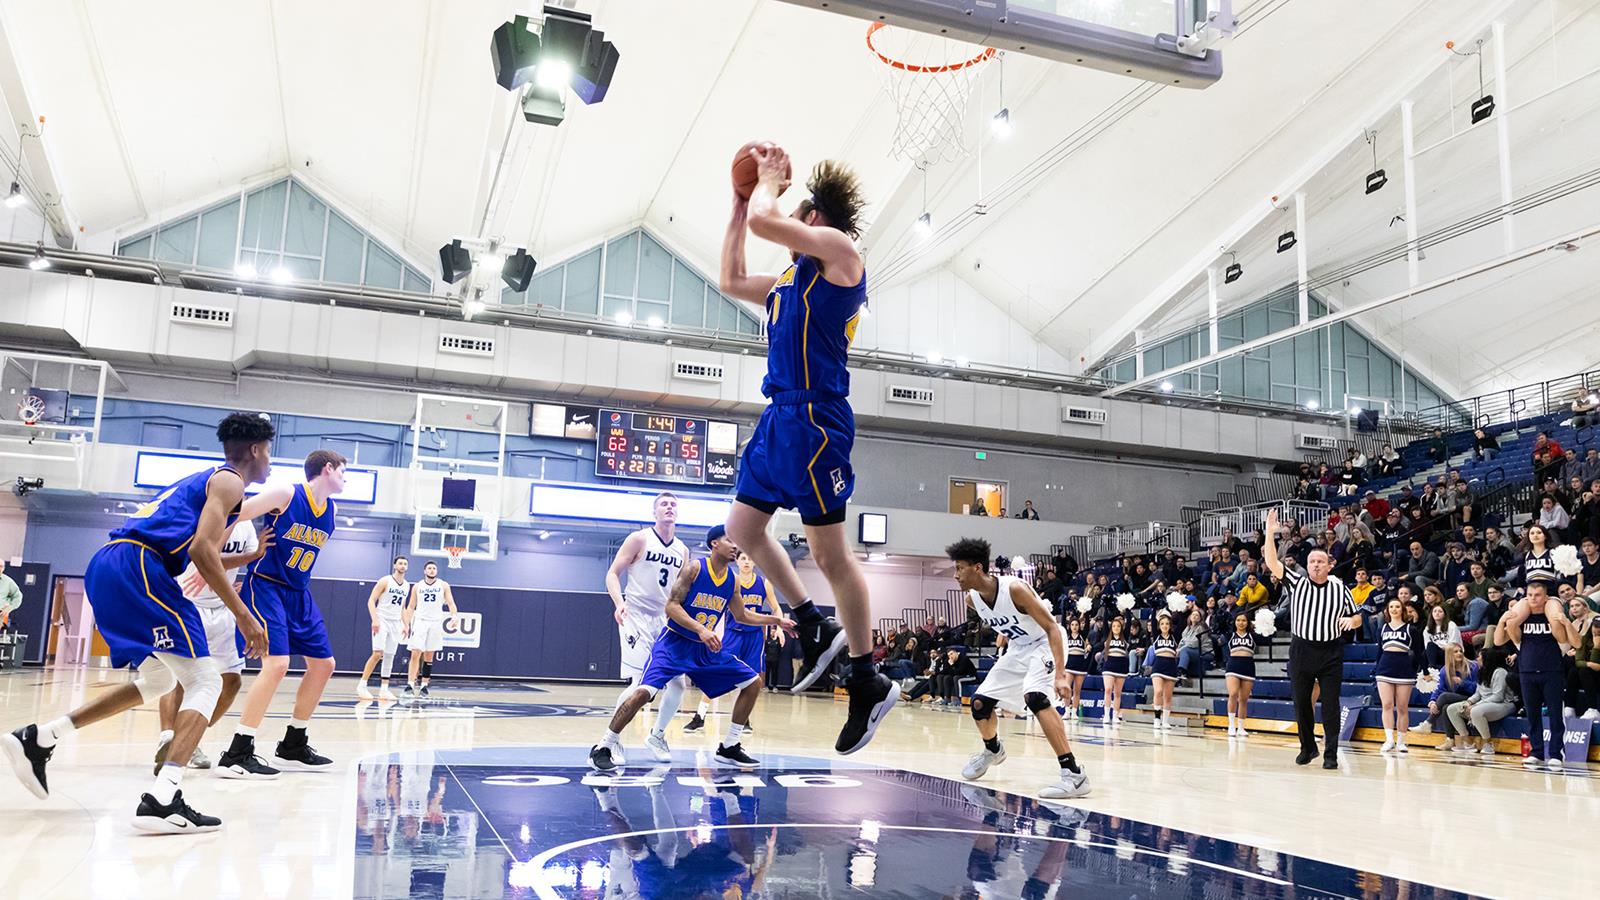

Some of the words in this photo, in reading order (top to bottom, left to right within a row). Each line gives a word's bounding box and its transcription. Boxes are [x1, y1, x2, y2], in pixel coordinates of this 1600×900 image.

[648, 416, 674, 431] 1:44
[608, 436, 627, 452] 62
[648, 441, 656, 453] 2
[681, 443, 699, 459] 55
[607, 458, 615, 470] 9
[619, 460, 626, 470] 2
[629, 460, 645, 473] 22
[647, 462, 655, 474] 3
[665, 463, 673, 476] 6
[707, 462, 735, 476] Woods
[694, 466, 701, 477] 7
[221, 540, 248, 553] WU
[286, 547, 316, 573] 10
[645, 550, 682, 569] WWU
[1526, 558, 1552, 570] WWU
[658, 567, 669, 588] 3
[391, 595, 403, 606] 24
[424, 593, 436, 602] 23
[442, 617, 477, 635] CU
[1523, 623, 1552, 635] WWU
[1382, 630, 1406, 640] WWU
[1232, 638, 1252, 647] WWU
[436, 652, 465, 662] URT
